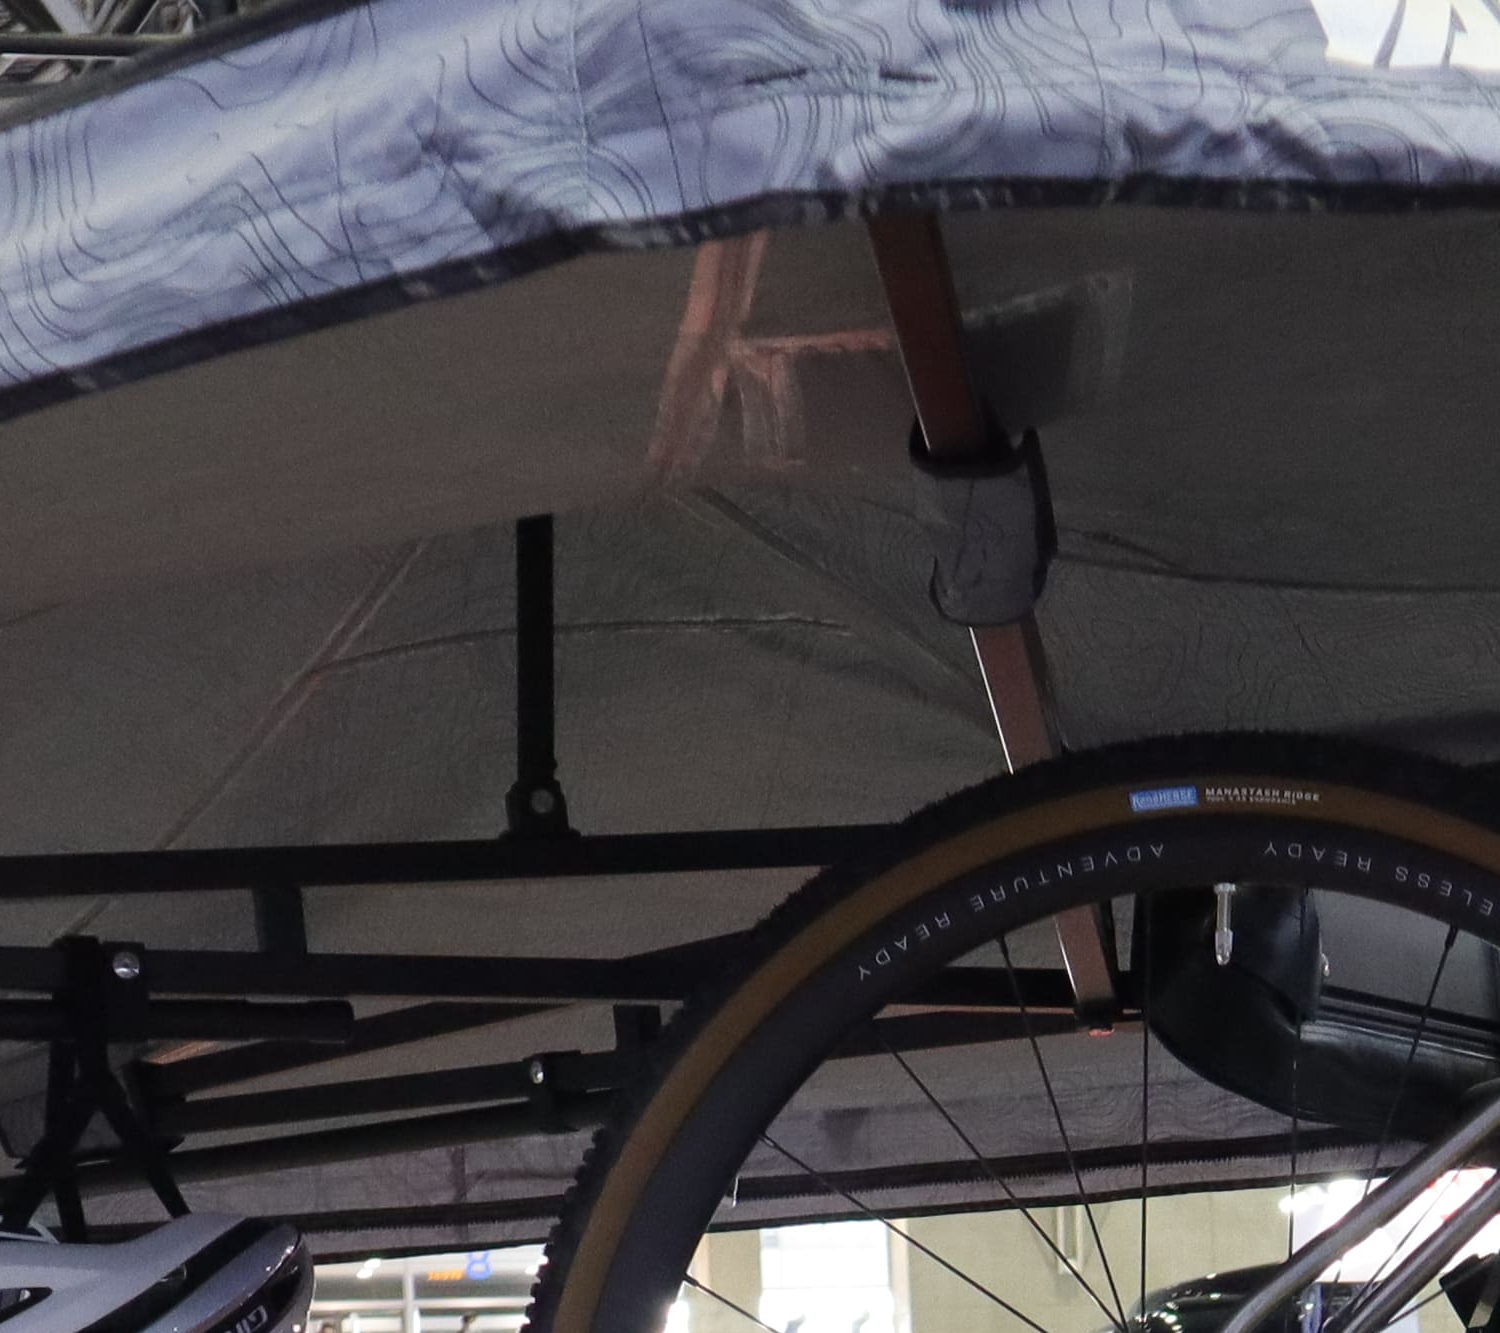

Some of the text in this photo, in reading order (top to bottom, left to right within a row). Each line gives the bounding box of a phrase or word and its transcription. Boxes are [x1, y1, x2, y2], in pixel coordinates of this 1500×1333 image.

[1263, 841, 1374, 873] READY
[857, 843, 1165, 981] ADVENTURE READY
